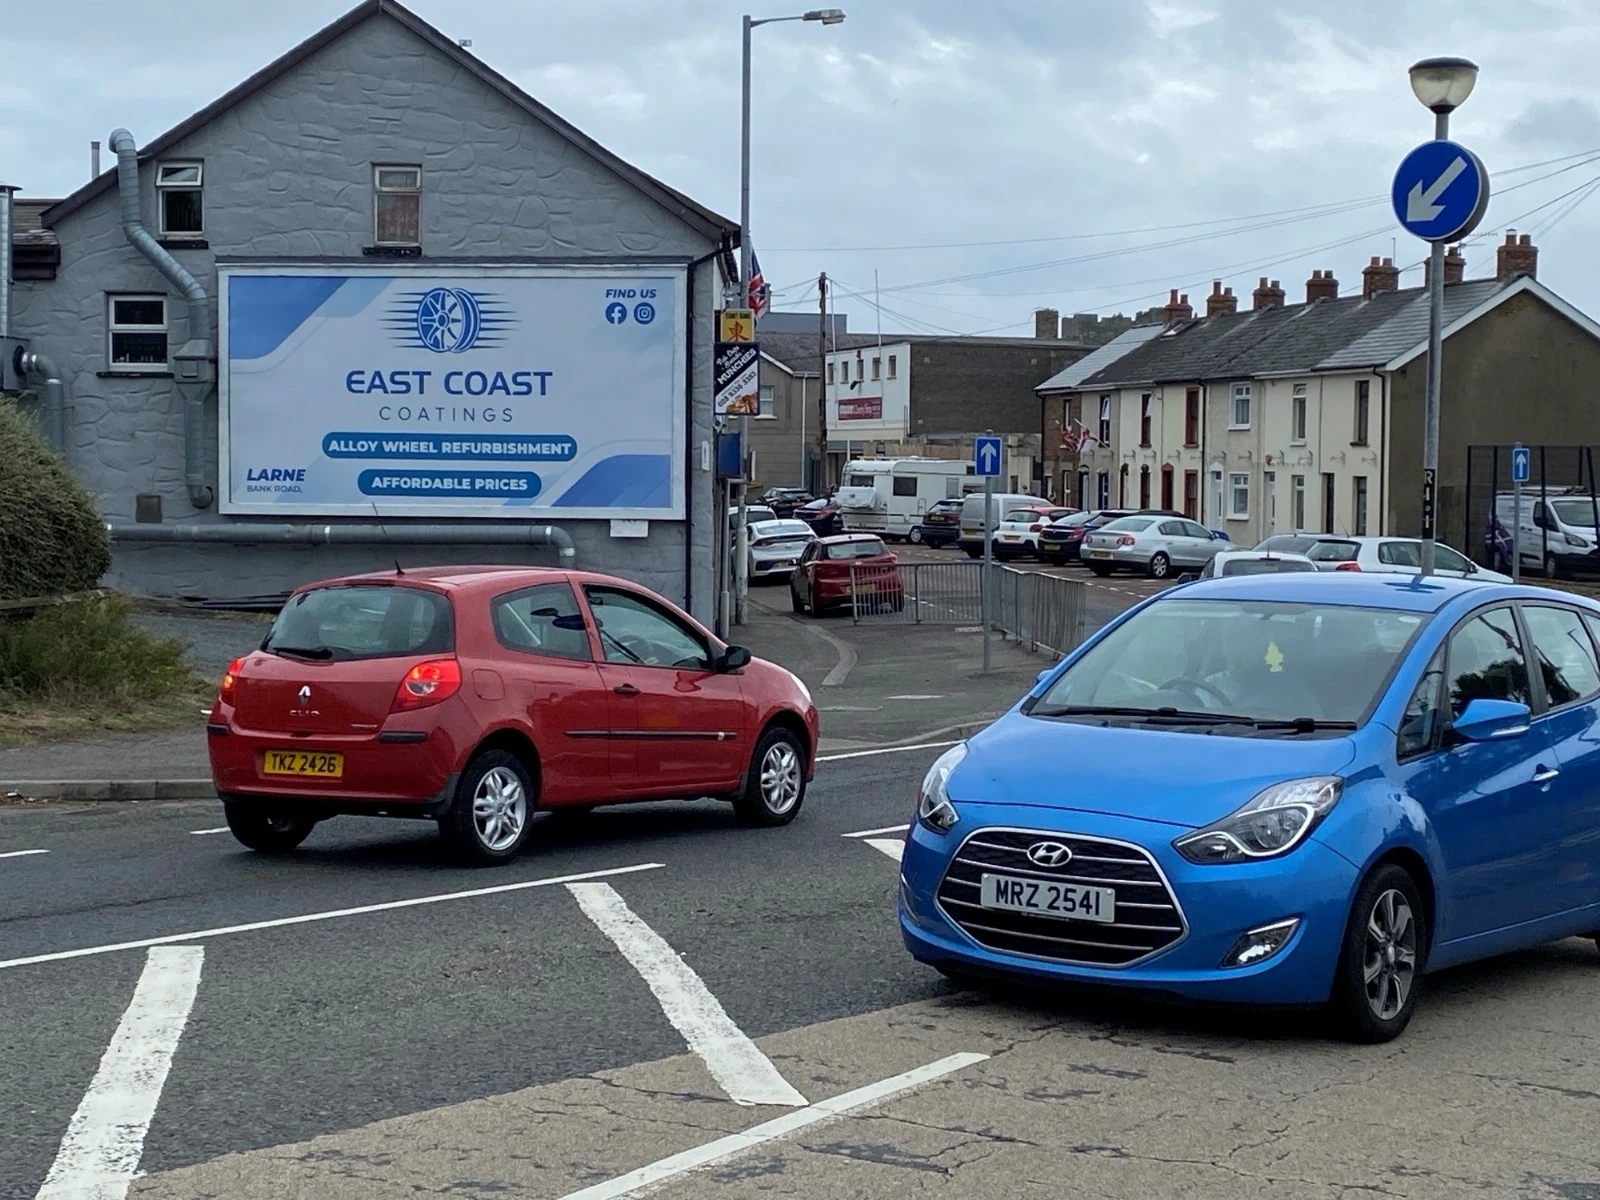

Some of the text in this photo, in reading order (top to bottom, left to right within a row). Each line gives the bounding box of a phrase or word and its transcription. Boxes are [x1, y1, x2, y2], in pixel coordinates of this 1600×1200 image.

[605, 289, 657, 298] FIND US
[717, 348, 757, 385] MUNCHIES
[346, 370, 553, 396] EAST COAST
[379, 406, 513, 423] COATINGS
[328, 440, 572, 455] ALLOY WHEEL REFURBISHMENT
[247, 468, 306, 481] LARNE
[371, 476, 528, 491] AFFORDABLE PRICES
[289, 709, 320, 717] CLIO
[271, 753, 337, 774] TKZ 2426
[996, 879, 1101, 916] MRZ 2541
